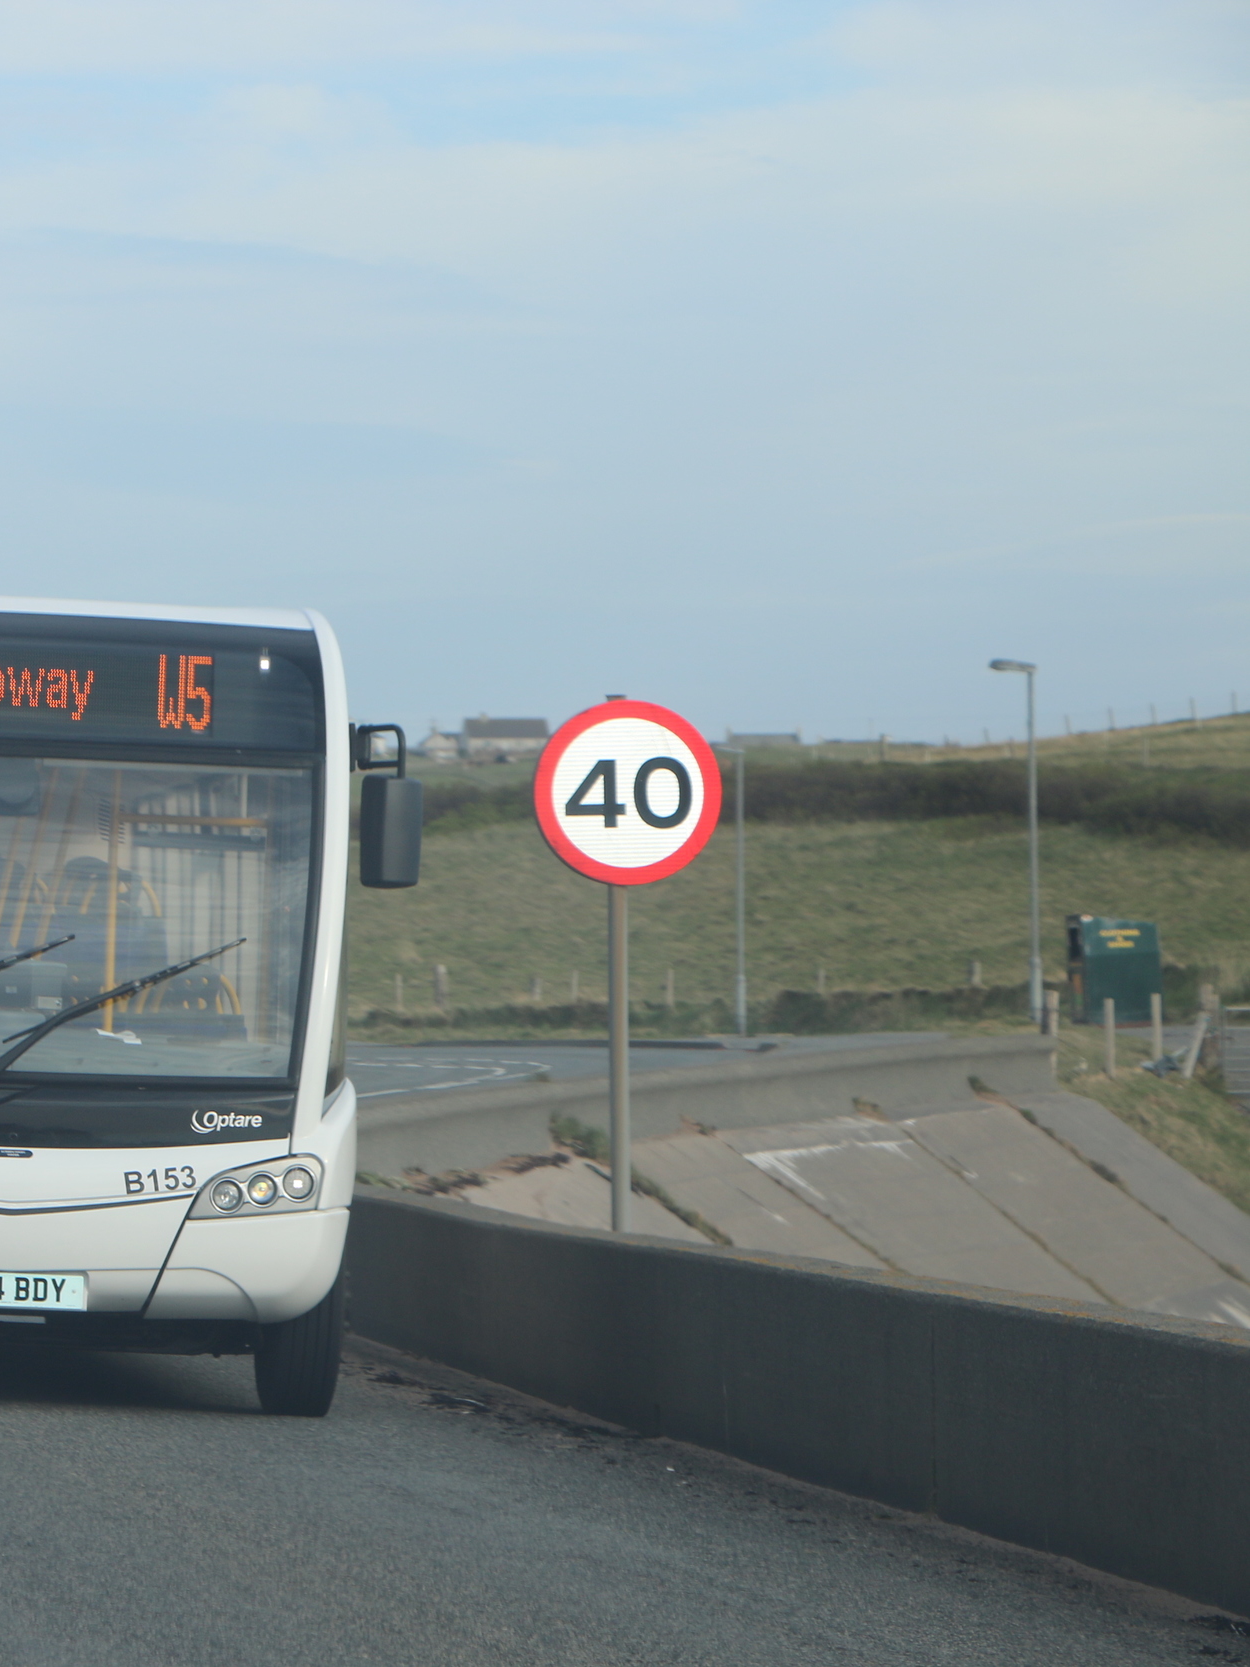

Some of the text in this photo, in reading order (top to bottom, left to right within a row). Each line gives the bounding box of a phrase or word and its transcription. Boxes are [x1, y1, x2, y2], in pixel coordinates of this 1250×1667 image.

[157, 654, 213, 730] W5
[565, 756, 693, 829] 40
[202, 1111, 263, 1131] Optare
[123, 1165, 197, 1195] B153
[14, 1276, 66, 1303] BDY
